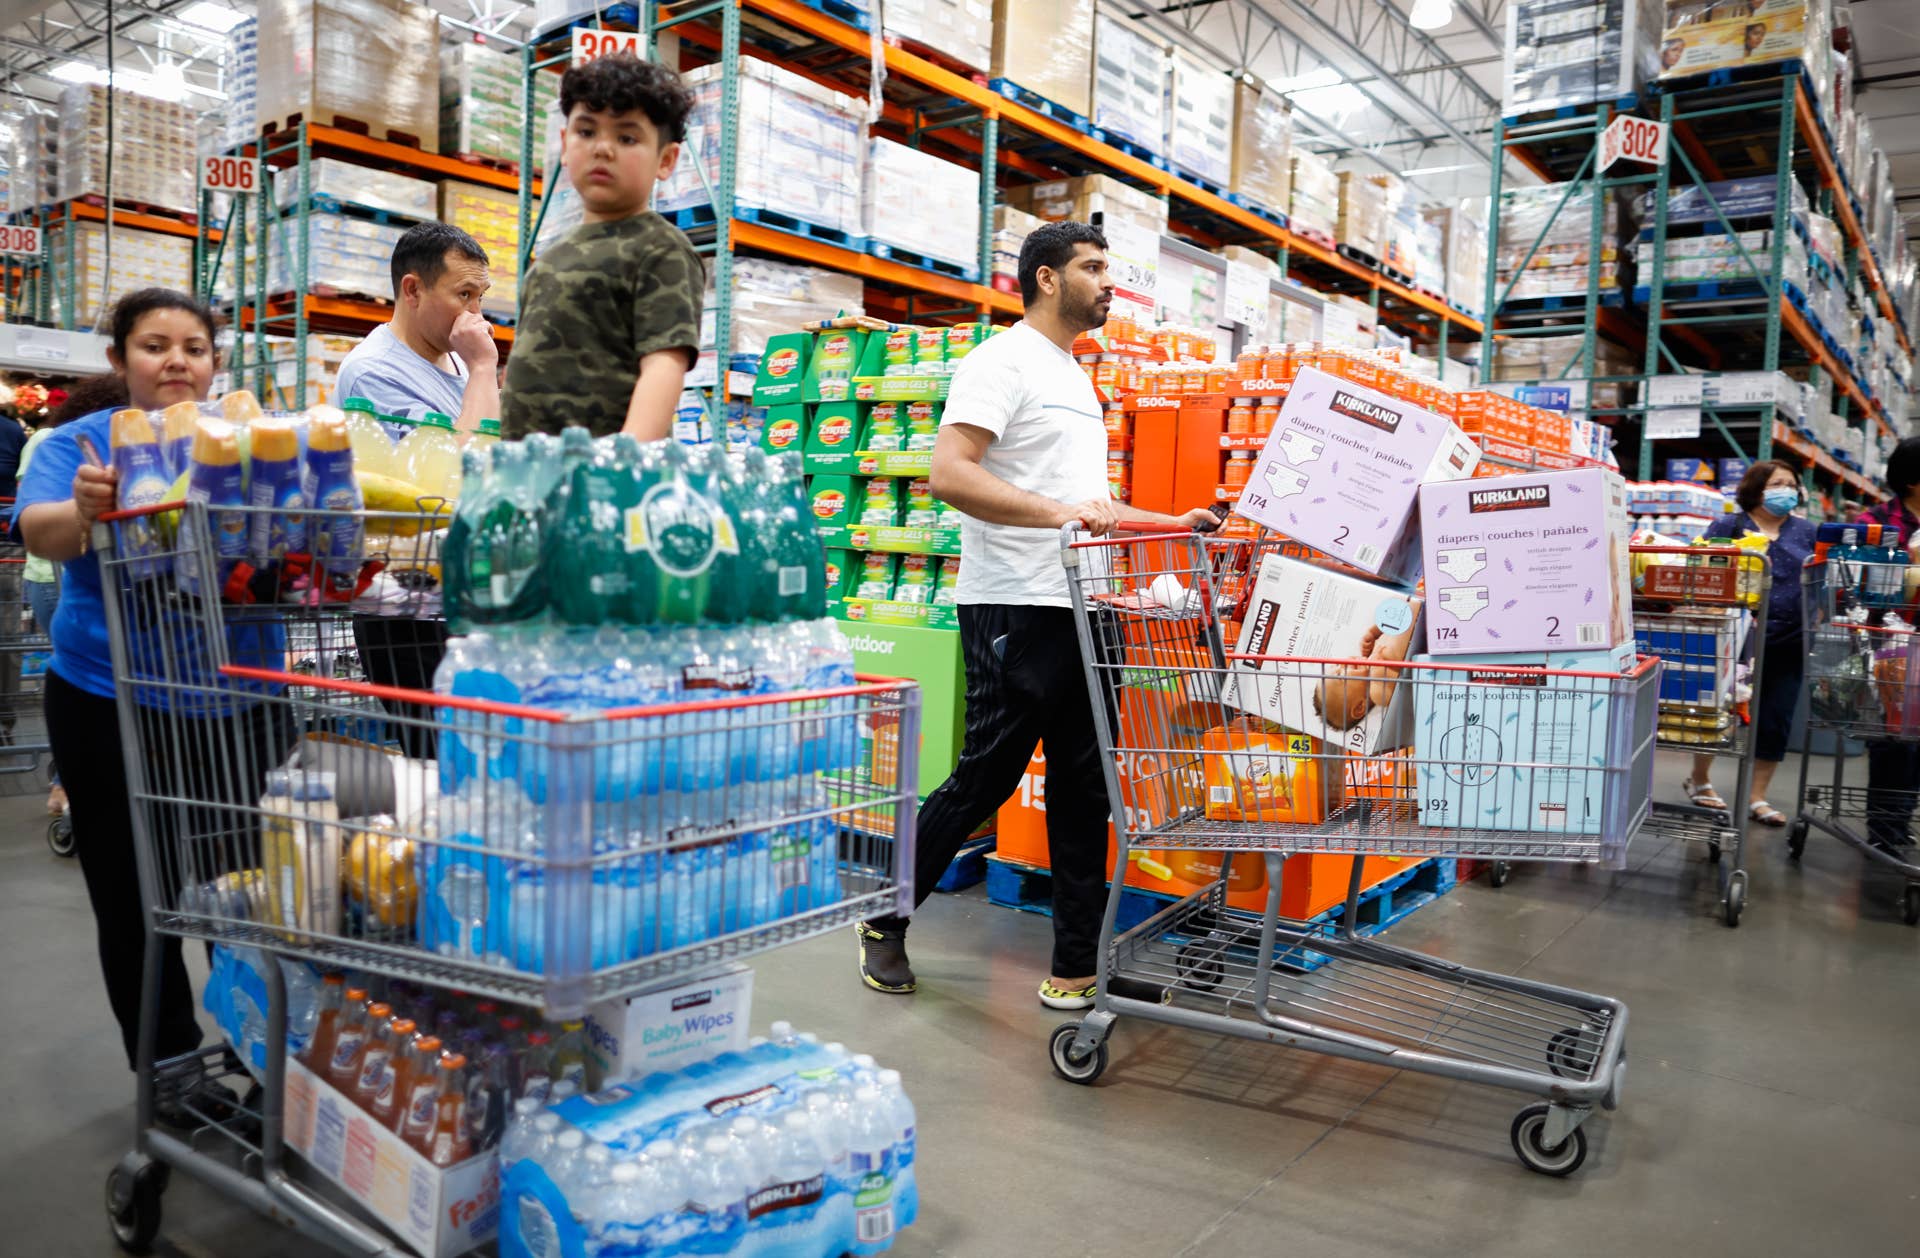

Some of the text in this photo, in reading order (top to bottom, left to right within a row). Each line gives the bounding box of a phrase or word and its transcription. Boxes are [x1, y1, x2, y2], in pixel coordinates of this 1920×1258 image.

[1623, 120, 1660, 160] 302
[206, 157, 253, 189] 306
[0, 226, 36, 251] 308
[1128, 265, 1157, 289] 29.99
[767, 354, 799, 370] ZYRTEC
[1241, 380, 1290, 392] 1500mg
[1136, 397, 1181, 409] 1500mg
[1336, 393, 1399, 425] KIRKLAND
[818, 423, 852, 436] ZYRTEC
[1290, 416, 1414, 471] diapers couches pañales
[813, 498, 845, 510] ZYRTEC
[1248, 492, 1268, 510] 174
[1472, 487, 1547, 505] KIRKLAND
[1333, 525, 1350, 546] 2
[1437, 524, 1589, 545] diapers couches pañales
[1436, 627, 1459, 640] 174
[1546, 616, 1561, 638] 2
[842, 632, 896, 654] utdoor
[1436, 691, 1478, 703] diapers
[1485, 690, 1531, 701] couches
[1290, 739, 1310, 752] 45
[1351, 725, 1367, 748] 192
[1426, 799, 1449, 811] 192
[750, 1174, 824, 1208] KIRKLAND
[861, 1175, 885, 1189] 40
